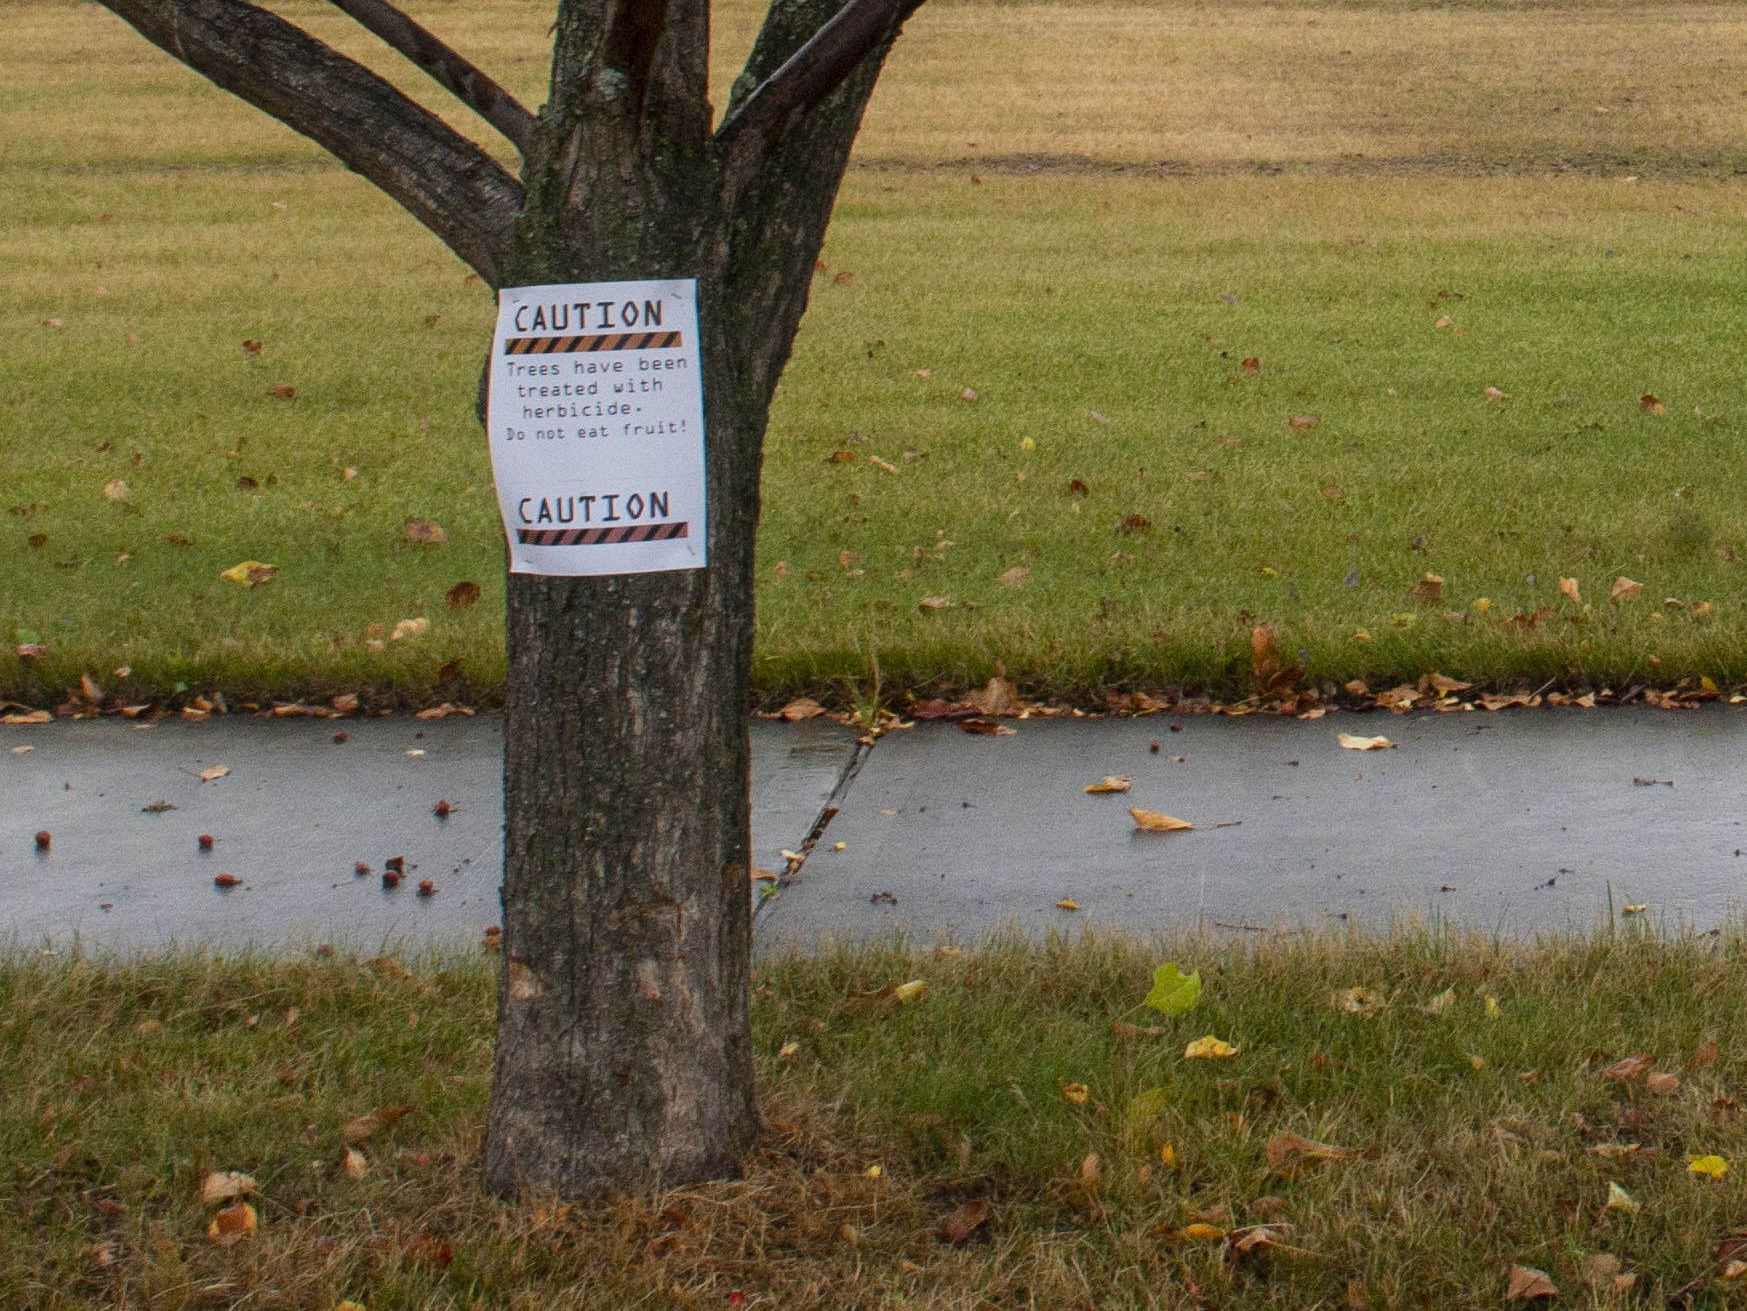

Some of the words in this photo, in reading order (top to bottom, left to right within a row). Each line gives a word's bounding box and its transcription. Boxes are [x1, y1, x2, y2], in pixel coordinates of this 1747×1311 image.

[514, 300, 663, 332] CAUTION
[507, 361, 560, 376] Trees
[574, 359, 624, 375] have
[638, 356, 688, 372] been
[518, 380, 598, 398] treated
[613, 377, 663, 394] with
[522, 401, 642, 419] herbicide.
[506, 427, 526, 441] Do
[536, 424, 566, 440] not
[577, 423, 609, 439] eat
[623, 419, 687, 437] fruit!
[518, 491, 670, 524] CAUTION
